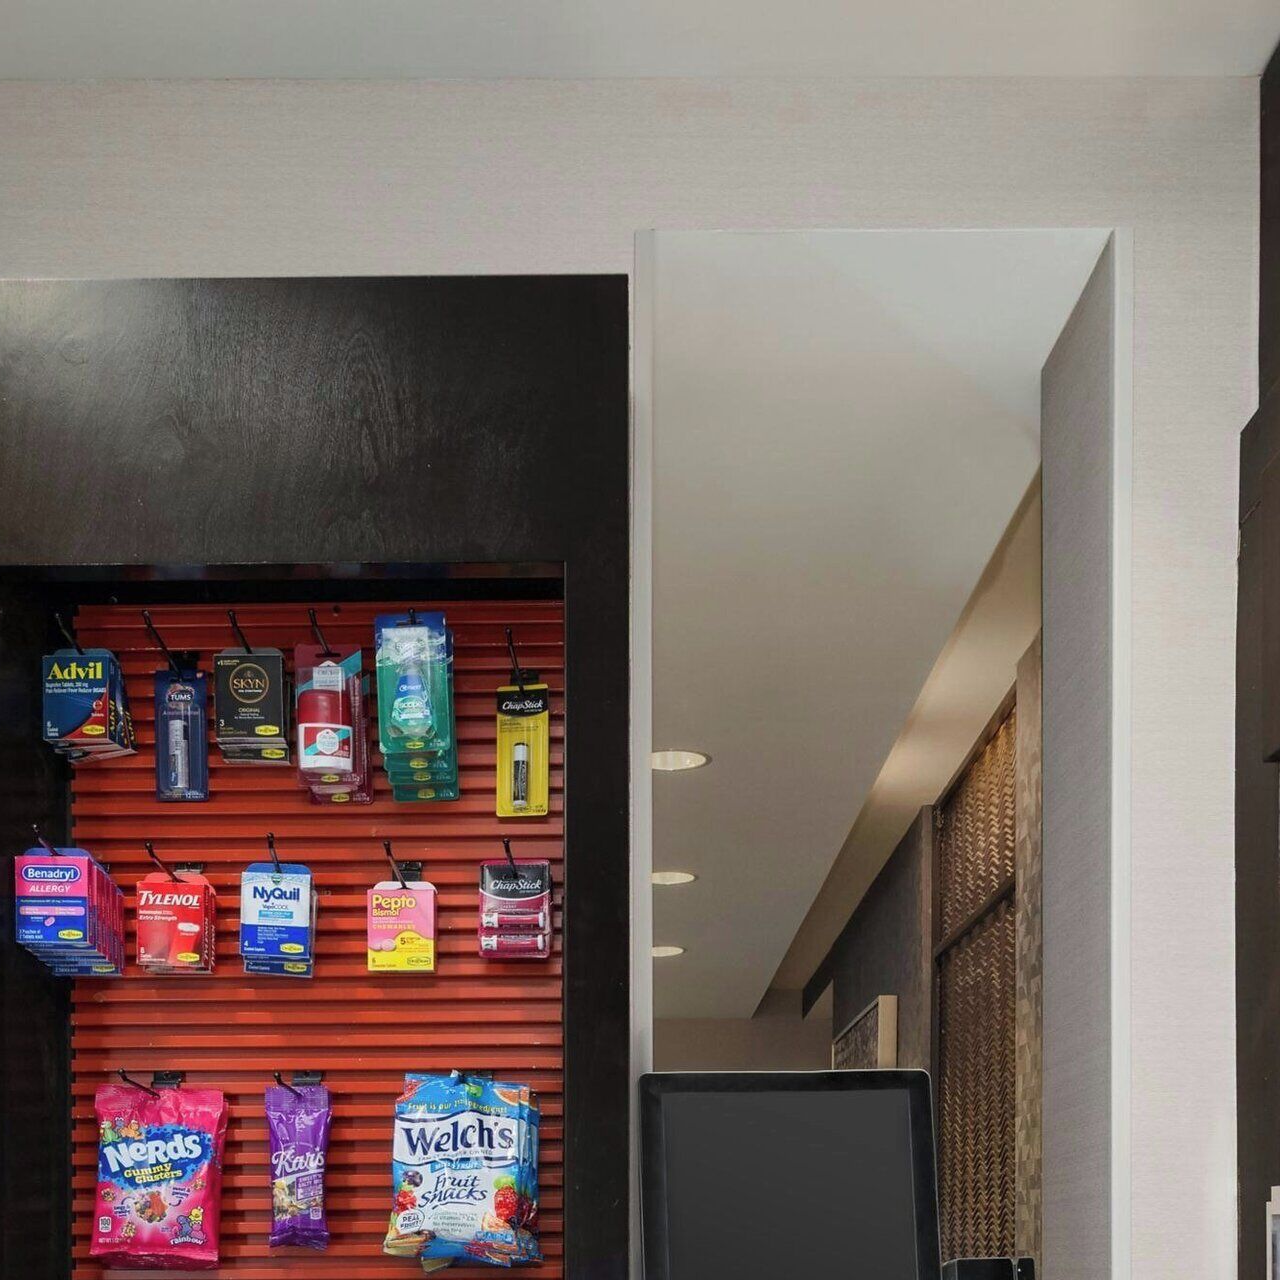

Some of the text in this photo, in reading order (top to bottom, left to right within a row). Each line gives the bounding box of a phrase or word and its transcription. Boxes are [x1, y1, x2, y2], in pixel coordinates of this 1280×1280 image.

[47, 662, 103, 679] Advil
[232, 679, 266, 691] SKYN
[501, 699, 544, 711] ChapStick
[27, 867, 75, 882] Benadryl
[28, 884, 71, 893] ALLERGY
[490, 878, 542, 891] ChapStick
[138, 890, 201, 907] TYLENOL
[253, 885, 300, 902] NyQuil
[371, 893, 417, 910] Pepto
[371, 908, 401, 917] Bismol
[402, 1117, 514, 1157] Welch's
[123, 1162, 172, 1178] Gummy
[135, 1169, 184, 1184] Clusters
[435, 1173, 481, 1192] Fruit
[418, 1187, 489, 1209] Snacks
[170, 1234, 204, 1245] rainbow
